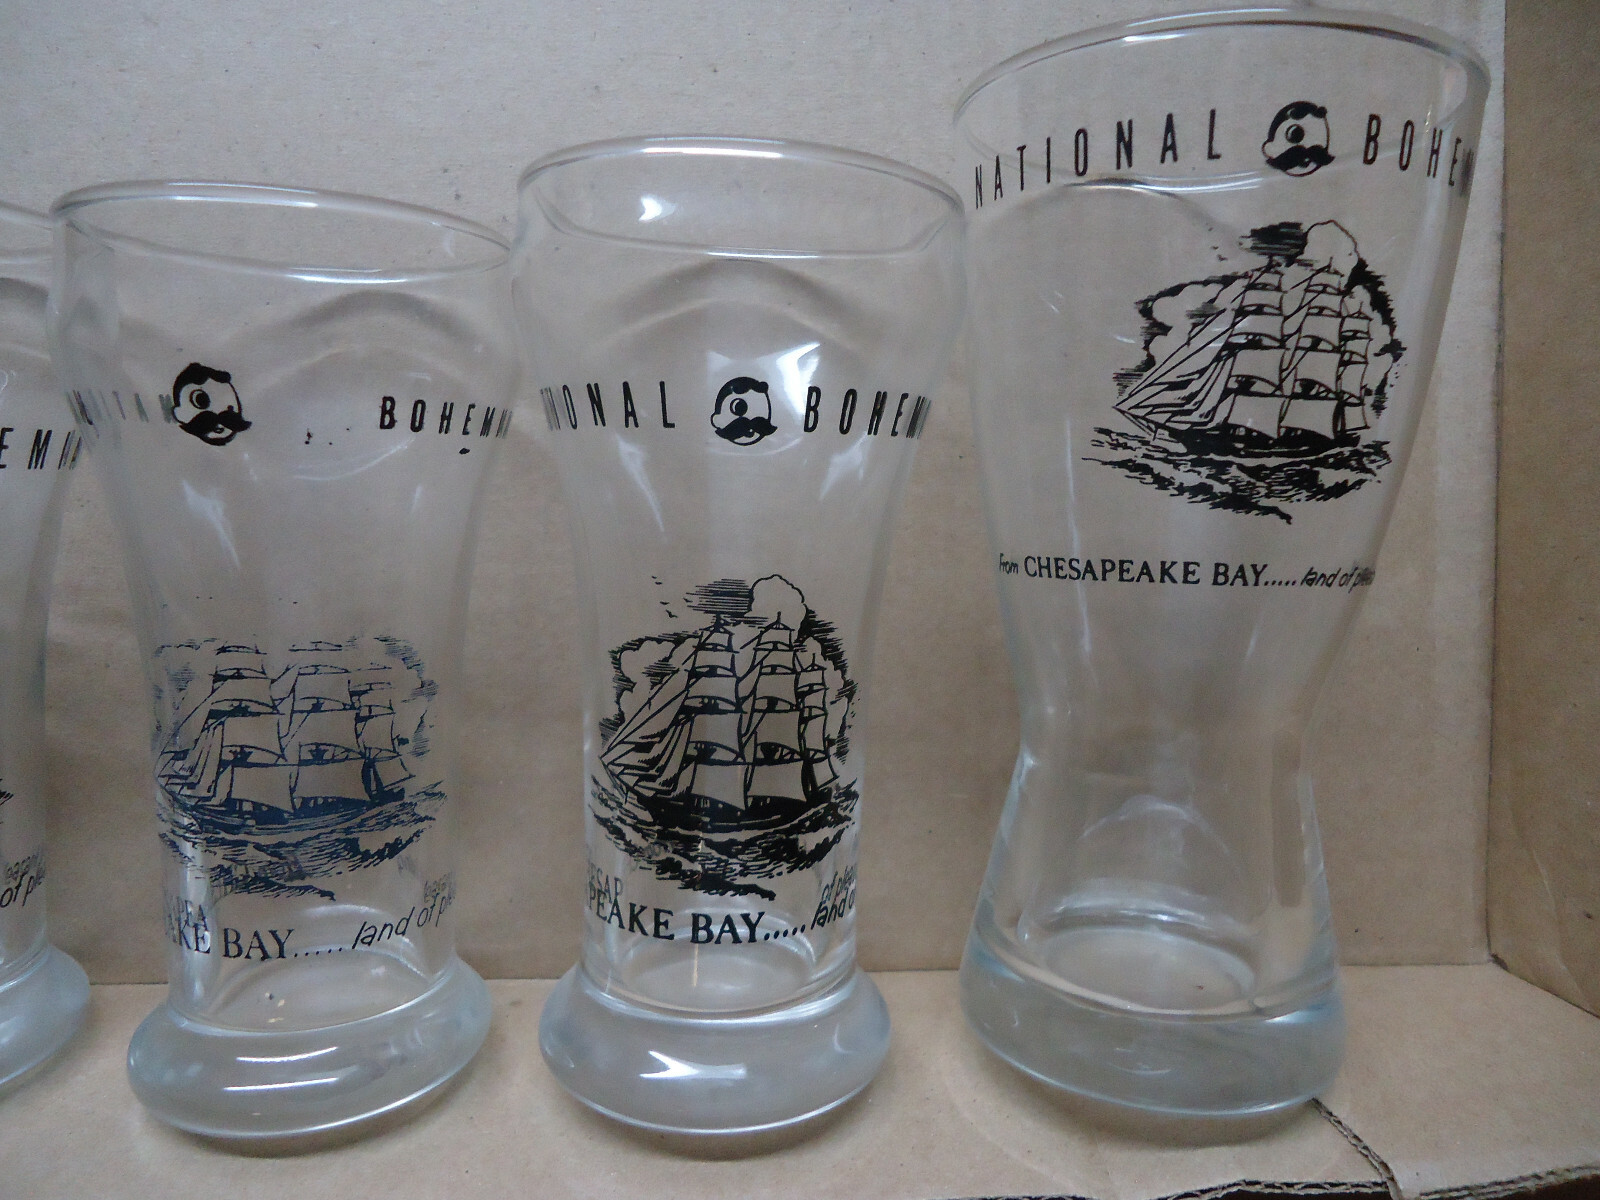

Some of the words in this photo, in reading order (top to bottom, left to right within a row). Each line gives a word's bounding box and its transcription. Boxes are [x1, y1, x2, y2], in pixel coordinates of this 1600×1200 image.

[975, 109, 1221, 209] NATIONAL
[1362, 113, 1474, 197] BOHE
[1023, 555, 1201, 585] CHESAPEAKE
[1301, 566, 1342, 588] land
[352, 906, 416, 949] land
